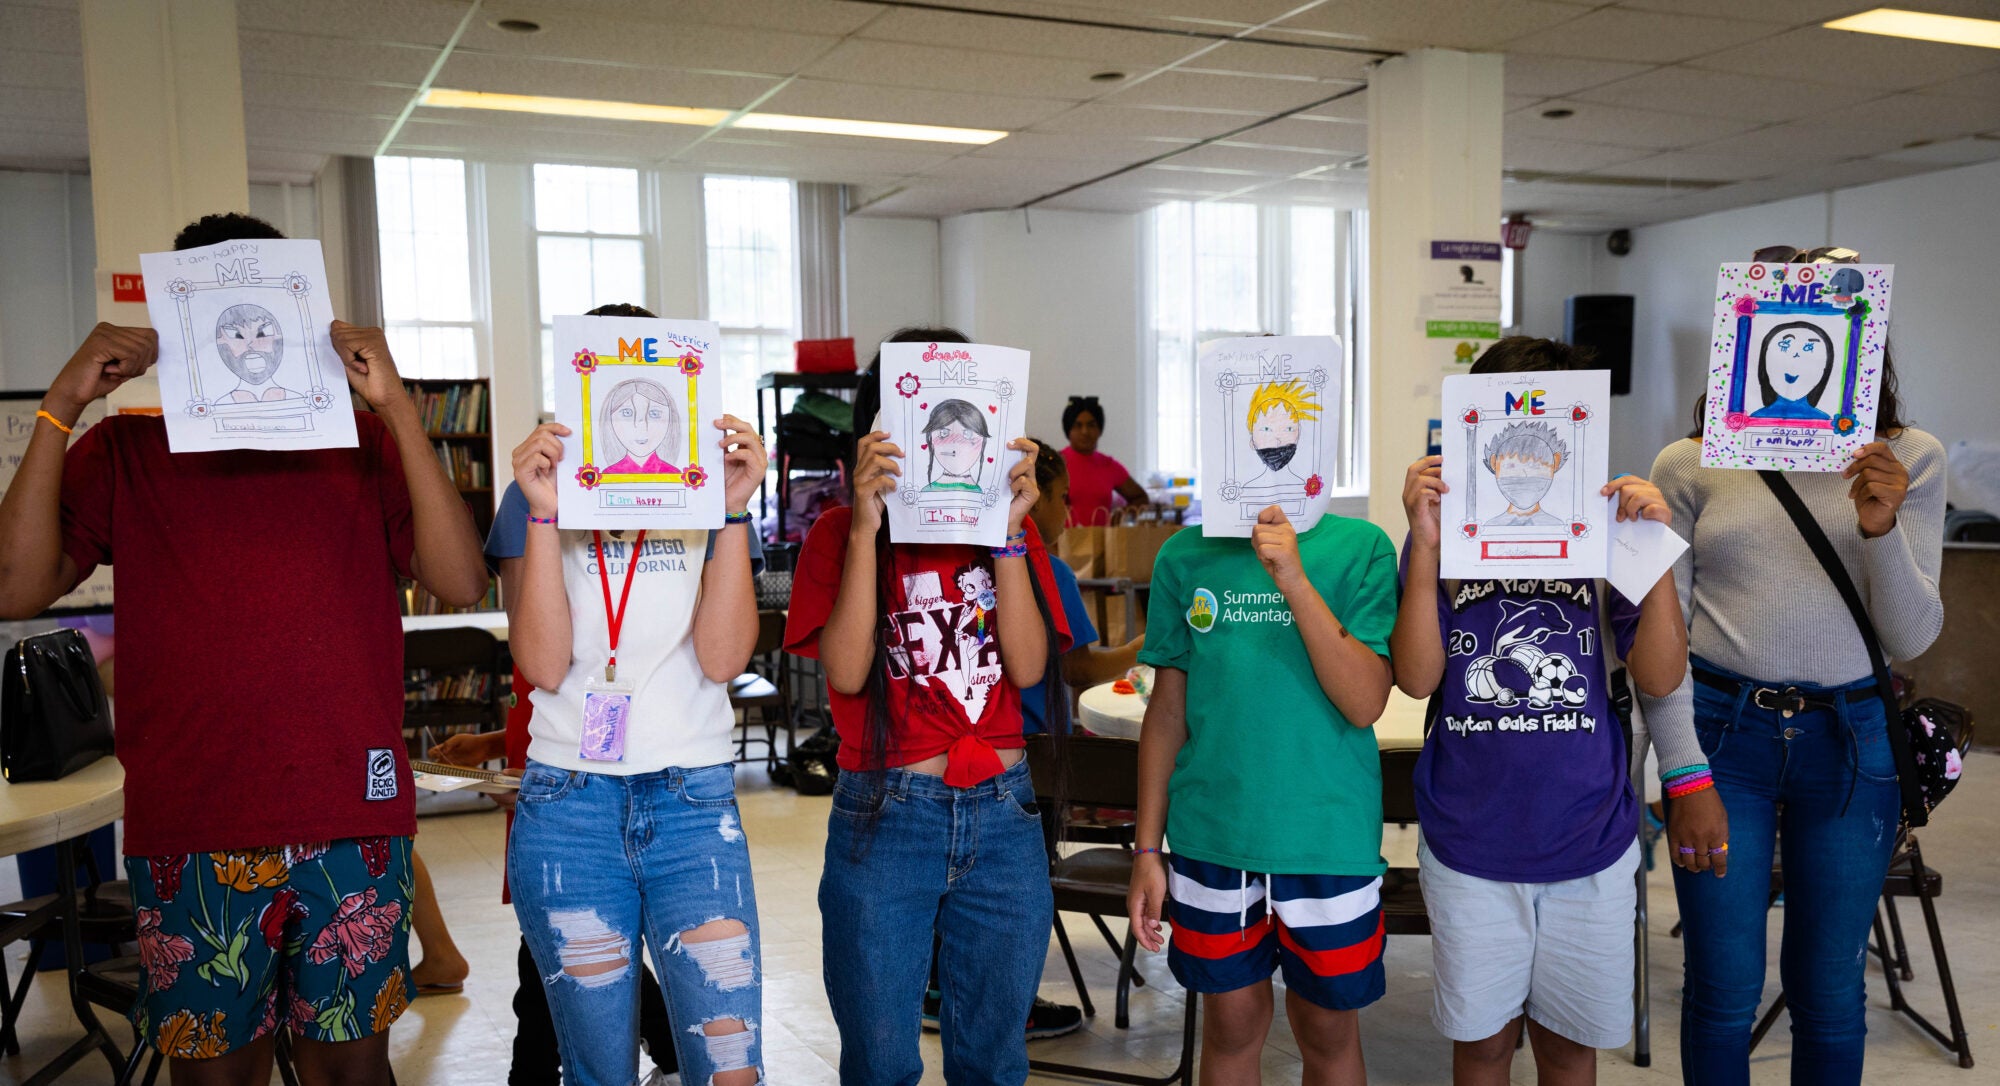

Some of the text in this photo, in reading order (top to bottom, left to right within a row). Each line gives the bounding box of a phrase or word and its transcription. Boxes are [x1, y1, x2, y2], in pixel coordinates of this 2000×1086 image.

[175, 243, 259, 266] I am happy
[215, 258, 262, 286] ME
[116, 277, 132, 290] La
[1781, 282, 1824, 307] ME
[618, 337, 659, 363] ME
[940, 361, 978, 386] ME
[1258, 354, 1292, 380] ME
[1505, 389, 1547, 416] ME
[1766, 437, 1782, 445] am
[1785, 436, 1815, 447] happy
[608, 494, 615, 506] I
[617, 496, 633, 505] am
[926, 508, 956, 522] I'm
[587, 541, 626, 559] SAN
[586, 559, 688, 575] CLIORNIA
[914, 594, 944, 610] bigger
[1223, 590, 1285, 605] Summer
[1454, 580, 1494, 609] otta
[1498, 578, 1541, 594] Play
[1222, 606, 1296, 626] Advantag
[884, 605, 1001, 679] EXA
[1448, 629, 1478, 657] 20
[970, 672, 997, 686] since
[1445, 715, 1493, 737] Dayton
[1497, 714, 1540, 732] Oaks
[1543, 712, 1577, 732] Field
[371, 787, 396, 797] UNLTD
